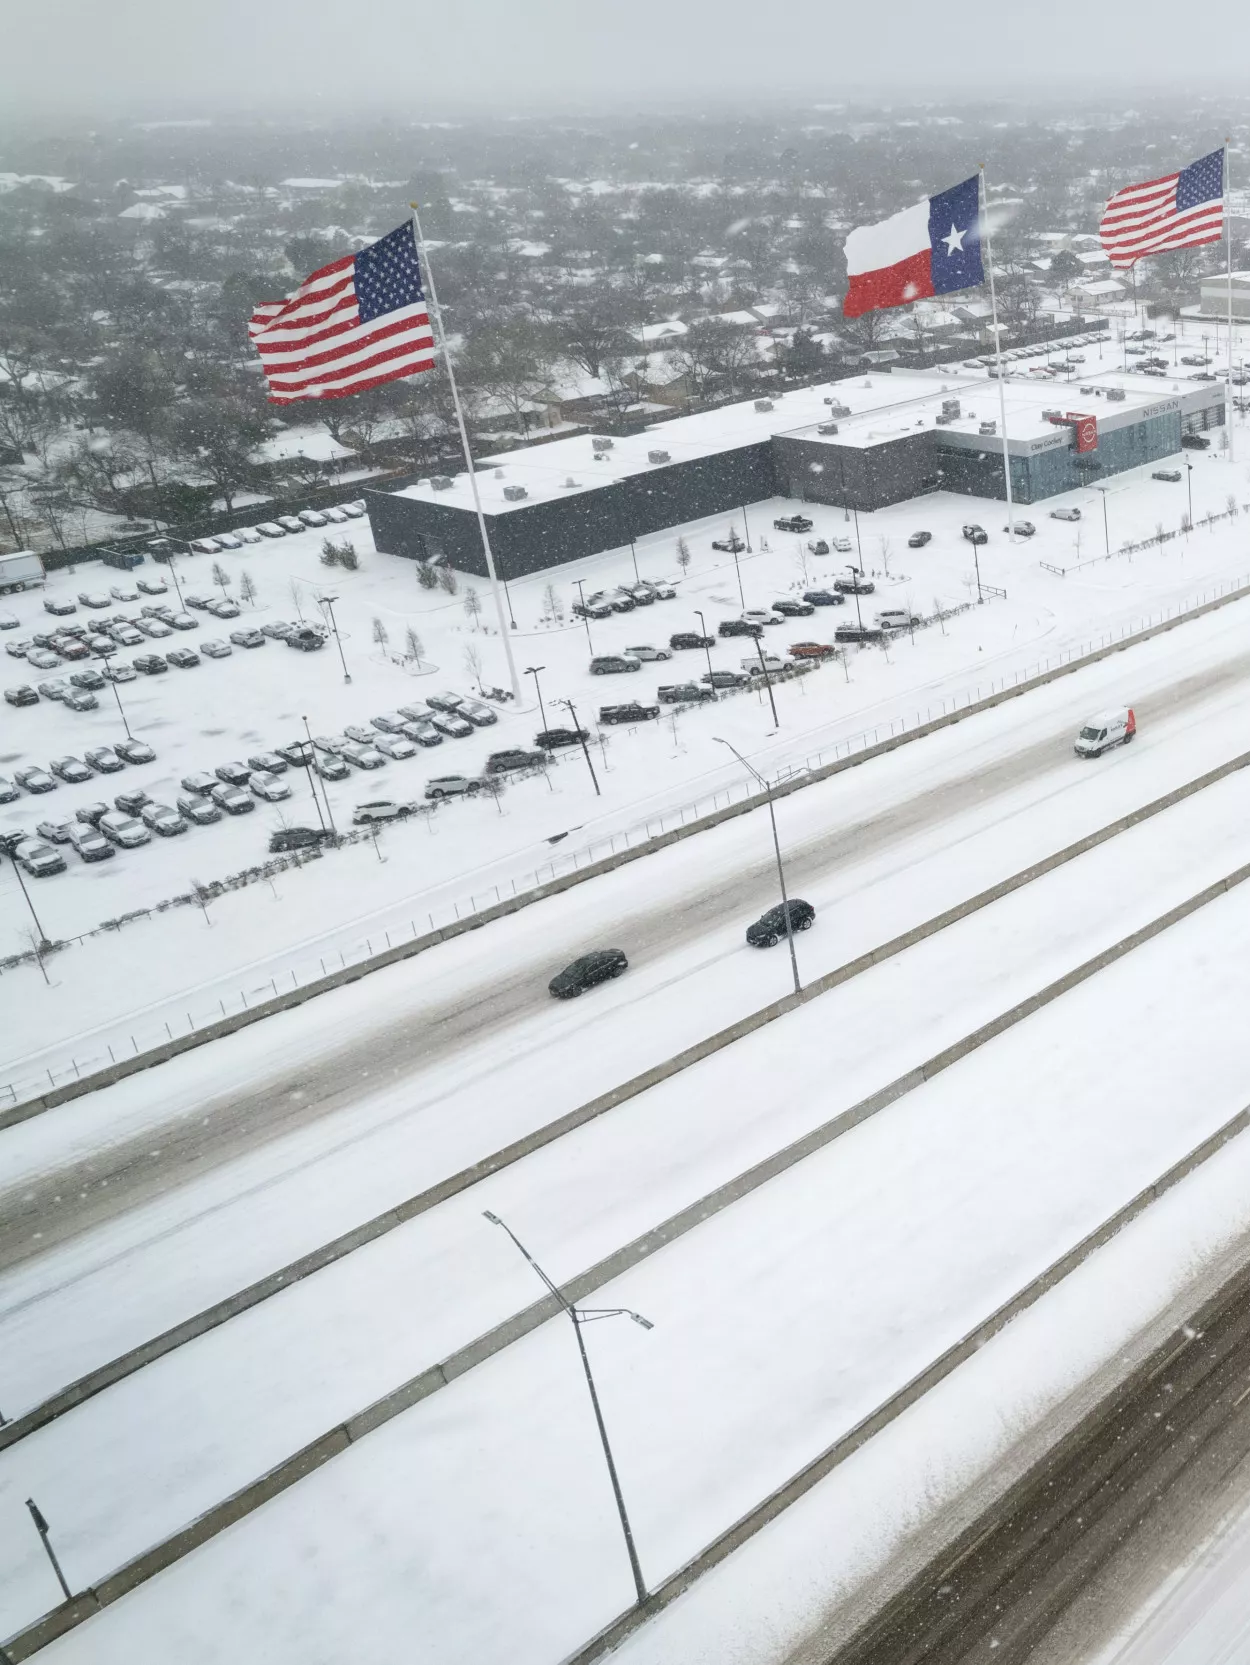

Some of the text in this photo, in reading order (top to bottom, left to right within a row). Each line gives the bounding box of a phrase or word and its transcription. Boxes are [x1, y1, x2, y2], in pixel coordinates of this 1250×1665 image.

[1143, 401, 1179, 417] NISSAN
[1031, 437, 1063, 451] Clay Cooley
